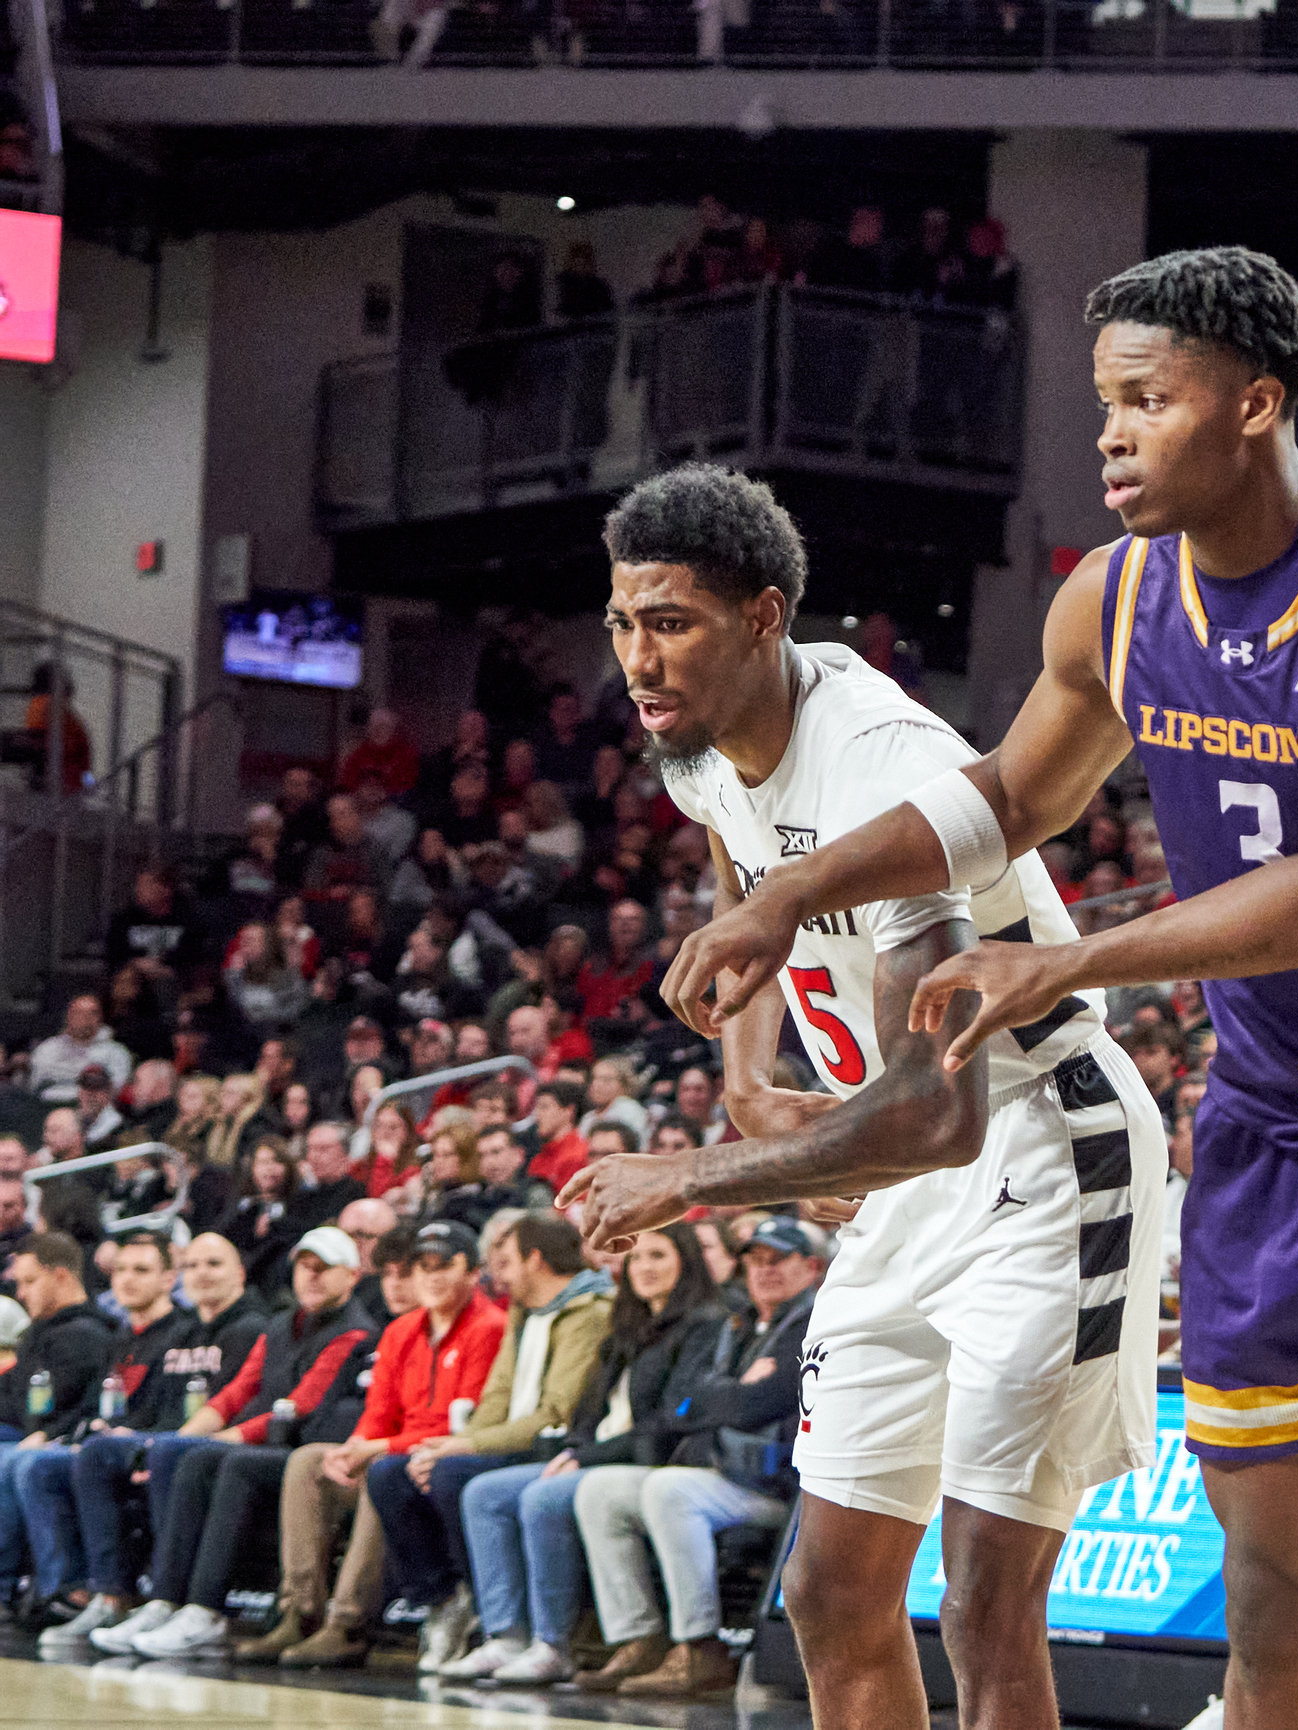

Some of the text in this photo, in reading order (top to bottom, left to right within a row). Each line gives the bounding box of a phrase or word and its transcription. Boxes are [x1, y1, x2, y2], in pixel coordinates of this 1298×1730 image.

[1218, 779, 1284, 864] 3
[786, 965, 867, 1086] 5
[1076, 1429, 1200, 1524] NE
[1056, 1529, 1181, 1601] RTIES
